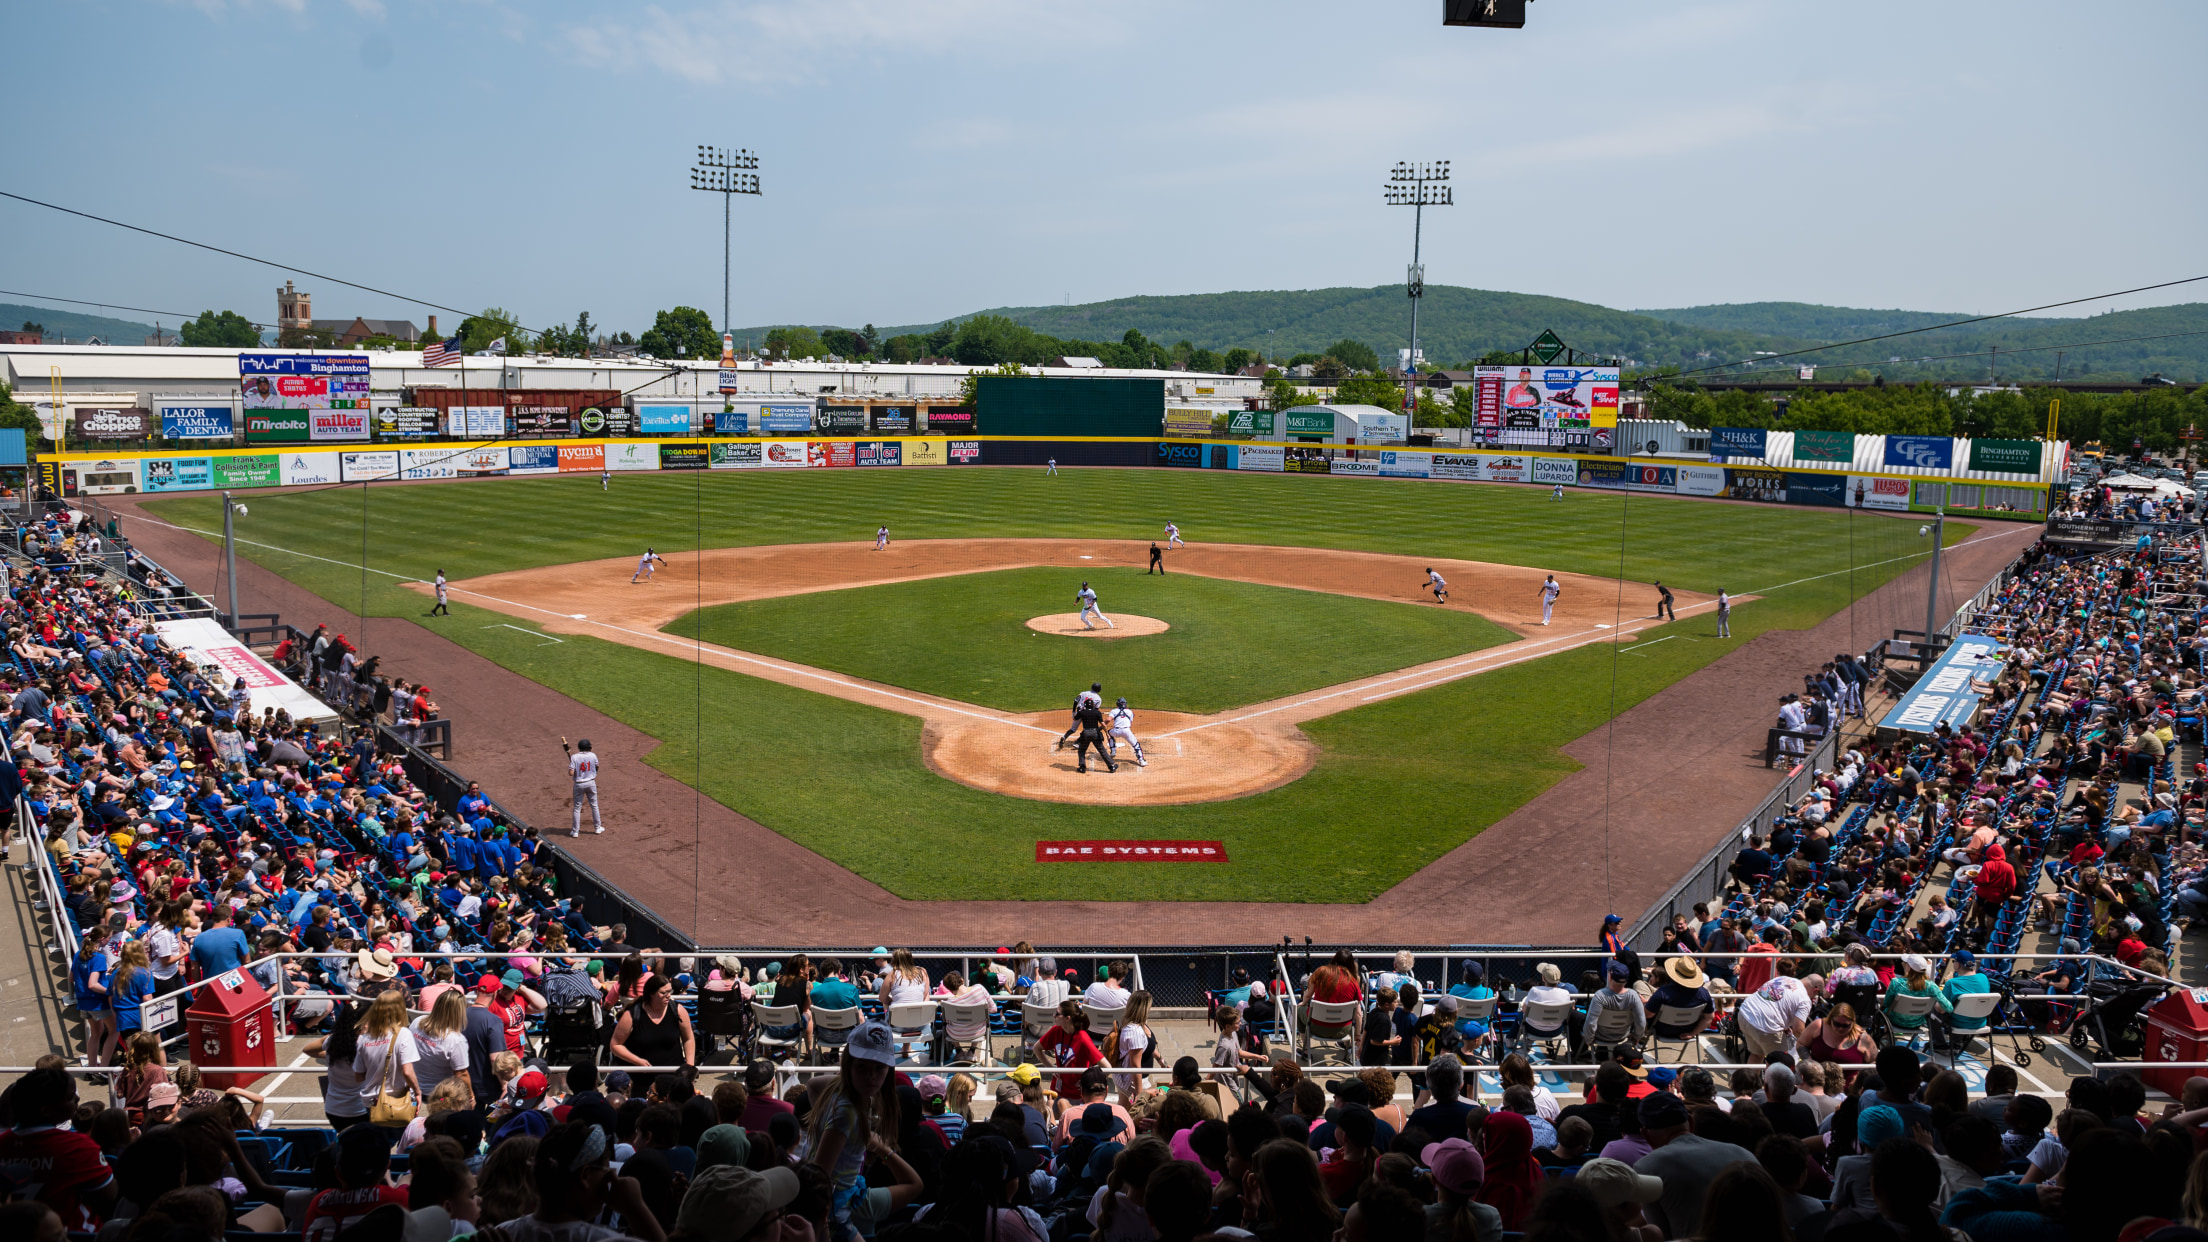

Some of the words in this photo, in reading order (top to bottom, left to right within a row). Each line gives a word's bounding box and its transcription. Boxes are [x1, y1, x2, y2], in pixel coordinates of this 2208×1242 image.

[310, 364, 368, 373] Binghamton
[108, 413, 141, 424] Price
[164, 409, 206, 418] LALOR
[177, 418, 219, 426] FAMILY
[316, 414, 362, 427] miller
[453, 410, 502, 431] IBM
[1287, 418, 1307, 426] M&T
[1308, 417, 1326, 427] Bank
[186, 427, 232, 435] DENTAL
[1721, 432, 1757, 443] HH&K
[1802, 434, 1849, 445] Shafer's
[559, 447, 593, 460] nycm
[1158, 443, 1198, 458] Sysco
[1980, 446, 2030, 456] BINGHAMTON
[467, 453, 498, 463] MTS
[1433, 456, 1478, 466] EVANS
[215, 463, 248, 471] Collision
[1536, 462, 1574, 472] DONNA
[1581, 461, 1624, 471] Electricians
[292, 475, 327, 484] Lourdes
[1536, 472, 1574, 481] LUPARDO
[1632, 468, 1673, 484] IOA
[1690, 471, 1719, 479] GUTHRIE
[1924, 666, 1972, 693] VISIONS
[1895, 693, 1950, 726] VISIONS
[580, 761, 590, 772] 41
[1425, 1037, 1435, 1060] 4
